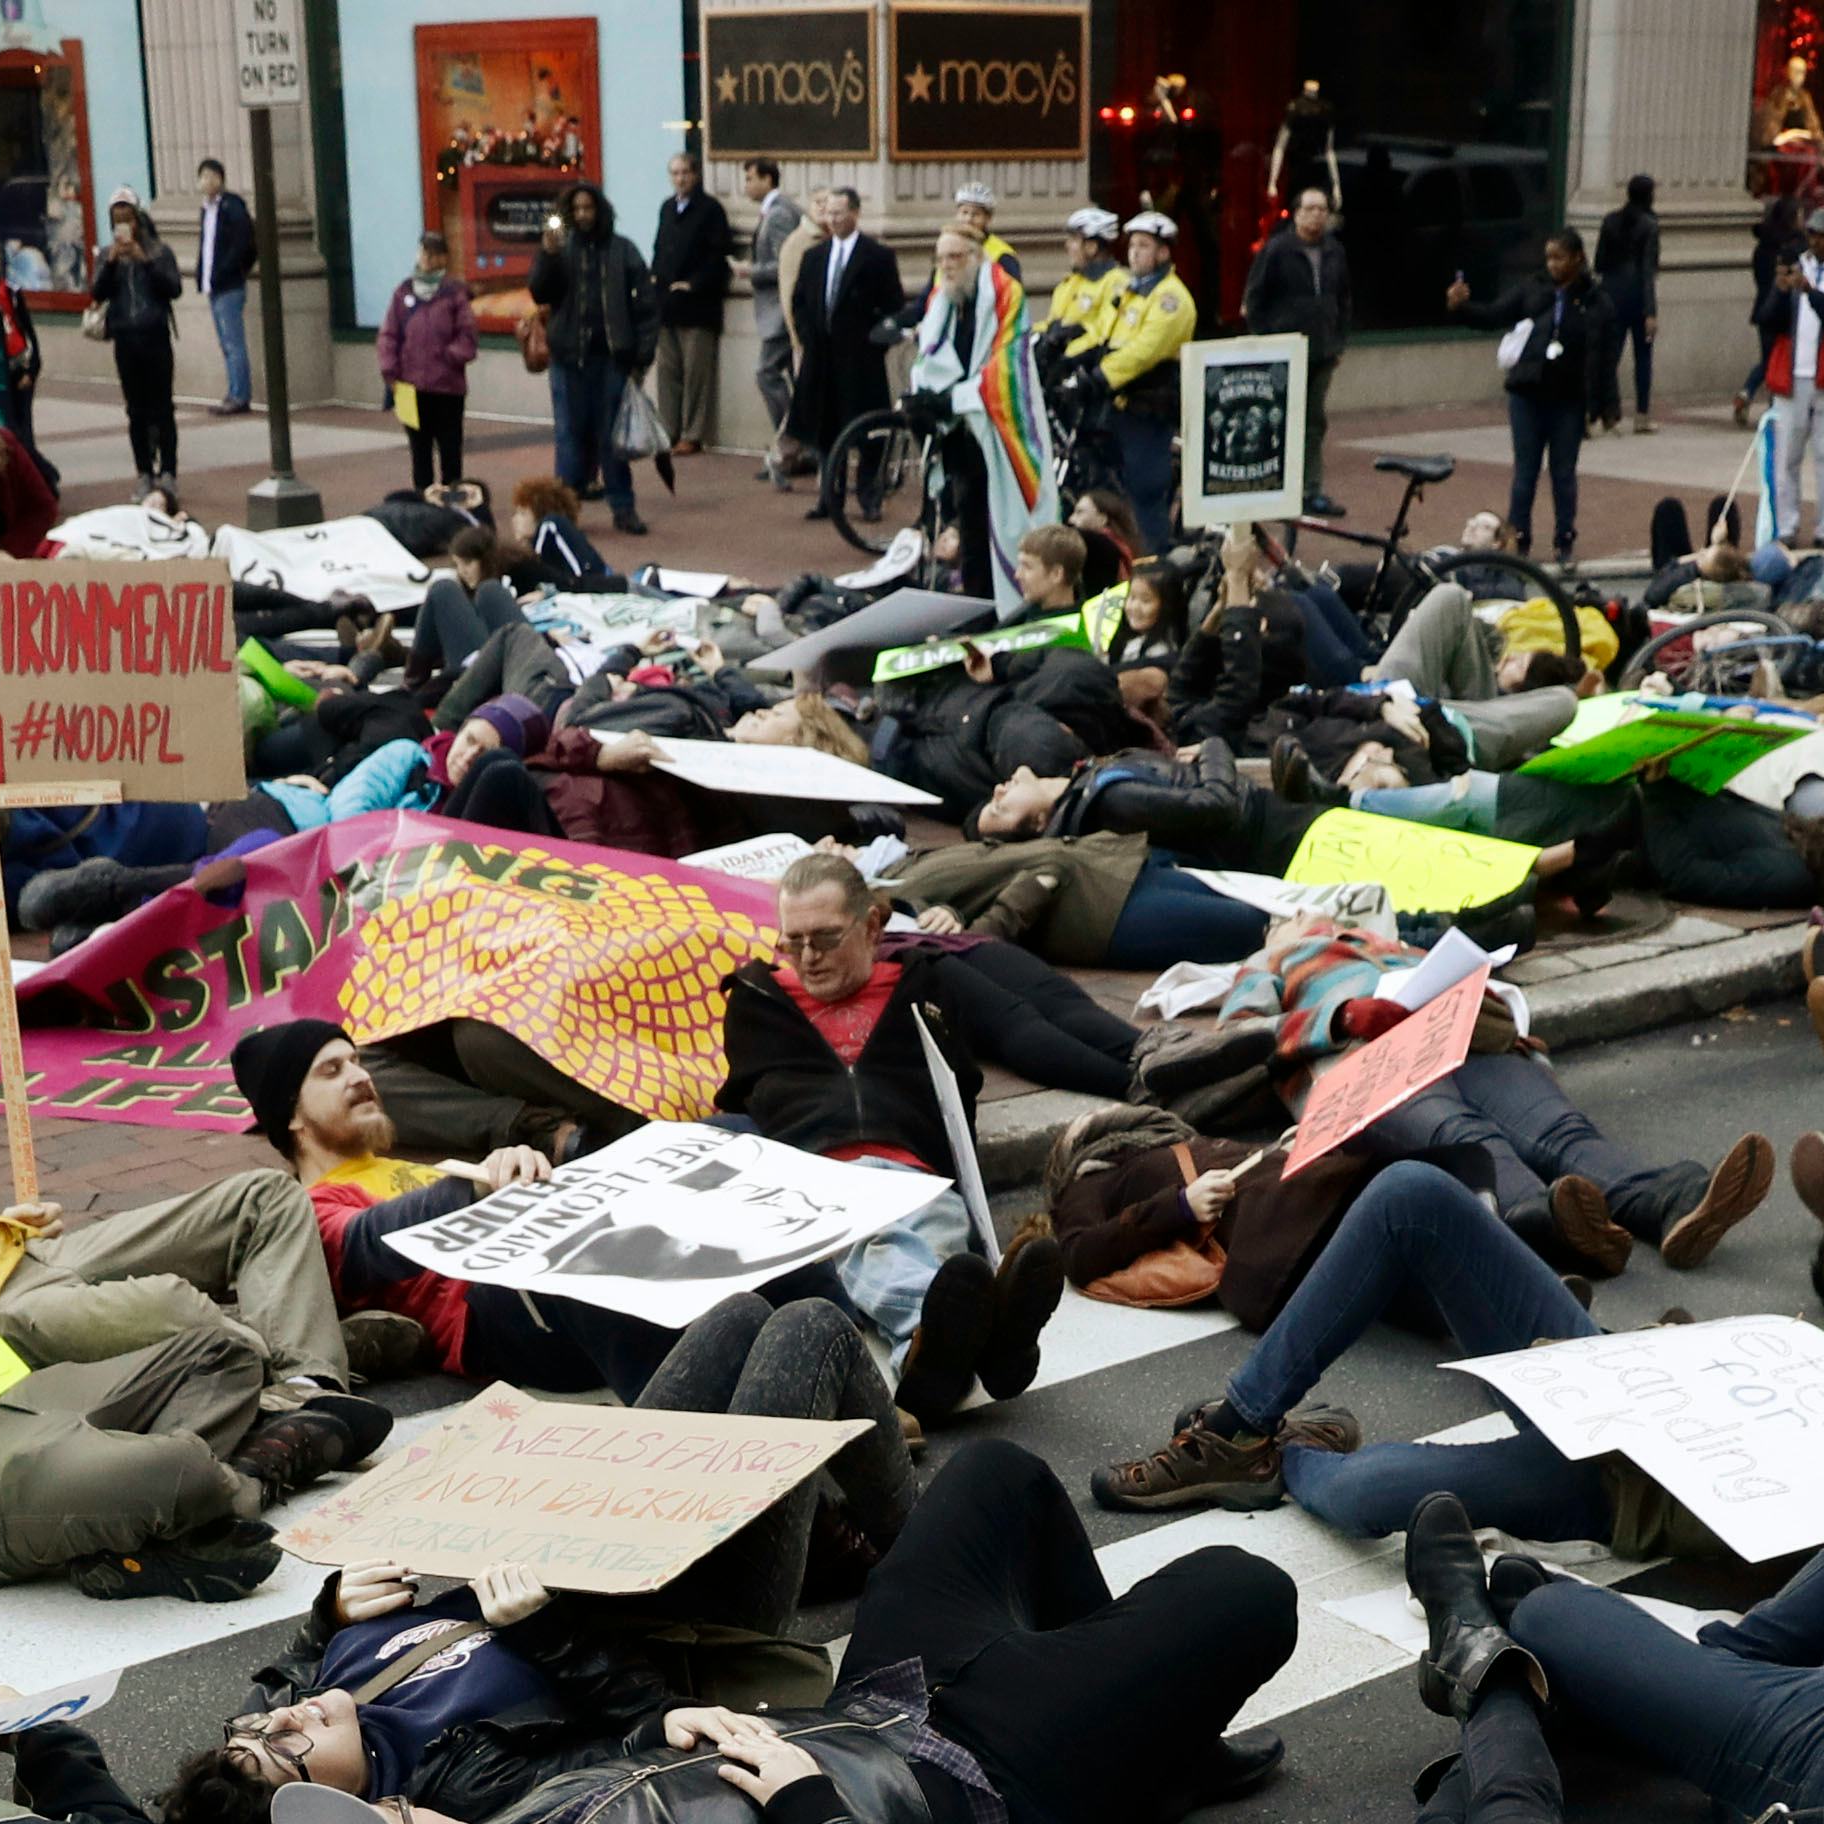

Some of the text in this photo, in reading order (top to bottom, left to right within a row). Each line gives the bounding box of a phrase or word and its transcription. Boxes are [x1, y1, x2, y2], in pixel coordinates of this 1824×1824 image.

[255, 0, 277, 20] NO
[247, 31, 290, 55] TURN
[241, 63, 297, 88] ON RED
[1209, 462, 1246, 481] WATER
[10, 701, 184, 766] #NODAPL
[492, 1424, 663, 1468] WELLS
[418, 1471, 752, 1524] NOW BACKING
[350, 1515, 507, 1555] BROKEN
